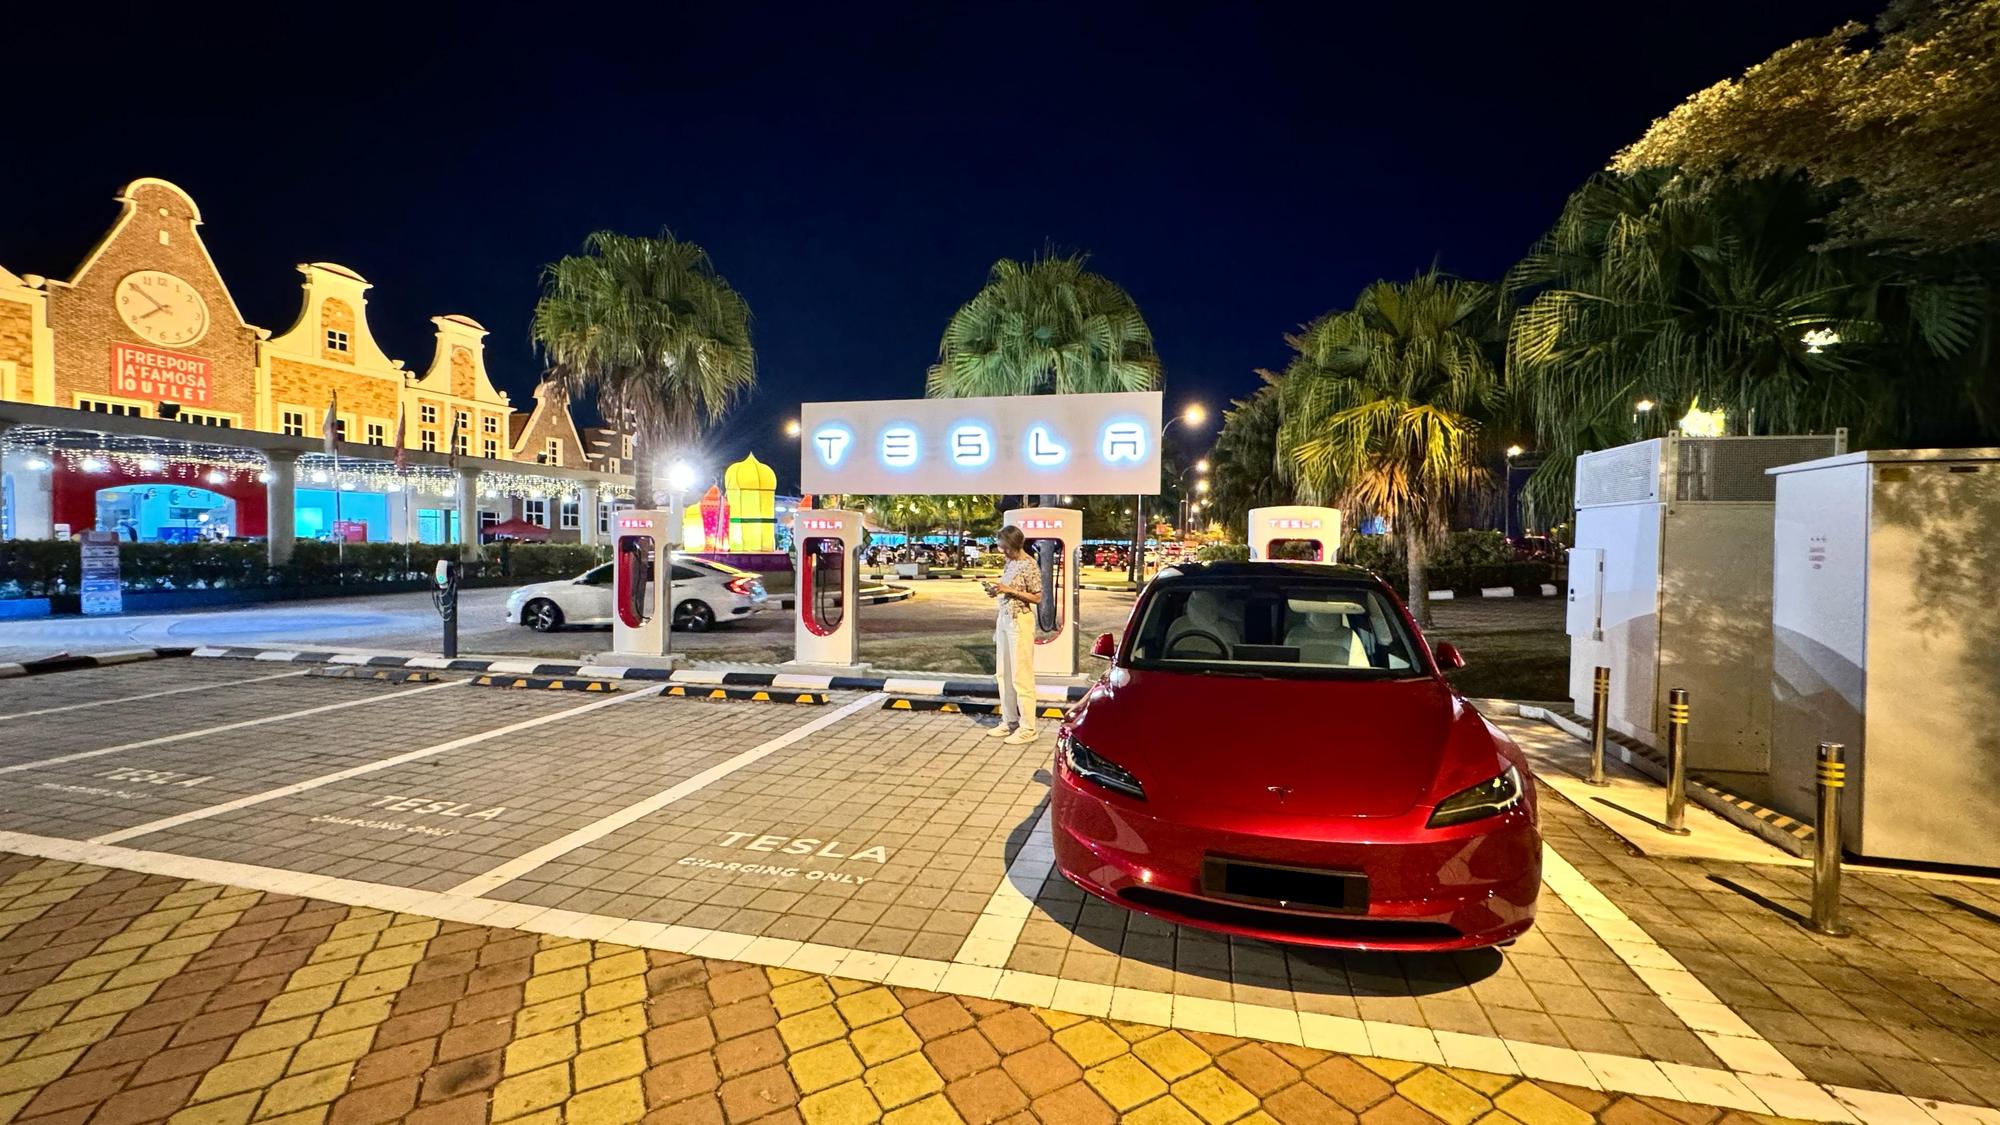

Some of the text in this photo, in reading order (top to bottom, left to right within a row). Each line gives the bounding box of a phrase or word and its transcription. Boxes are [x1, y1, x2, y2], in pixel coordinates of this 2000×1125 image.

[121, 295, 130, 305] 9
[186, 294, 194, 303] 2
[125, 349, 206, 374] FREEPORT
[125, 378, 206, 401] OUTLET
[816, 419, 1143, 464] TESLA
[618, 519, 653, 529] TESLA
[803, 520, 843, 529] TESLA
[1018, 519, 1063, 529] TESLA
[1269, 519, 1321, 529] TESLA
[370, 795, 507, 820] TESLA
[719, 831, 888, 864] TESLA
[676, 856, 873, 885] CHARGING ONLY
